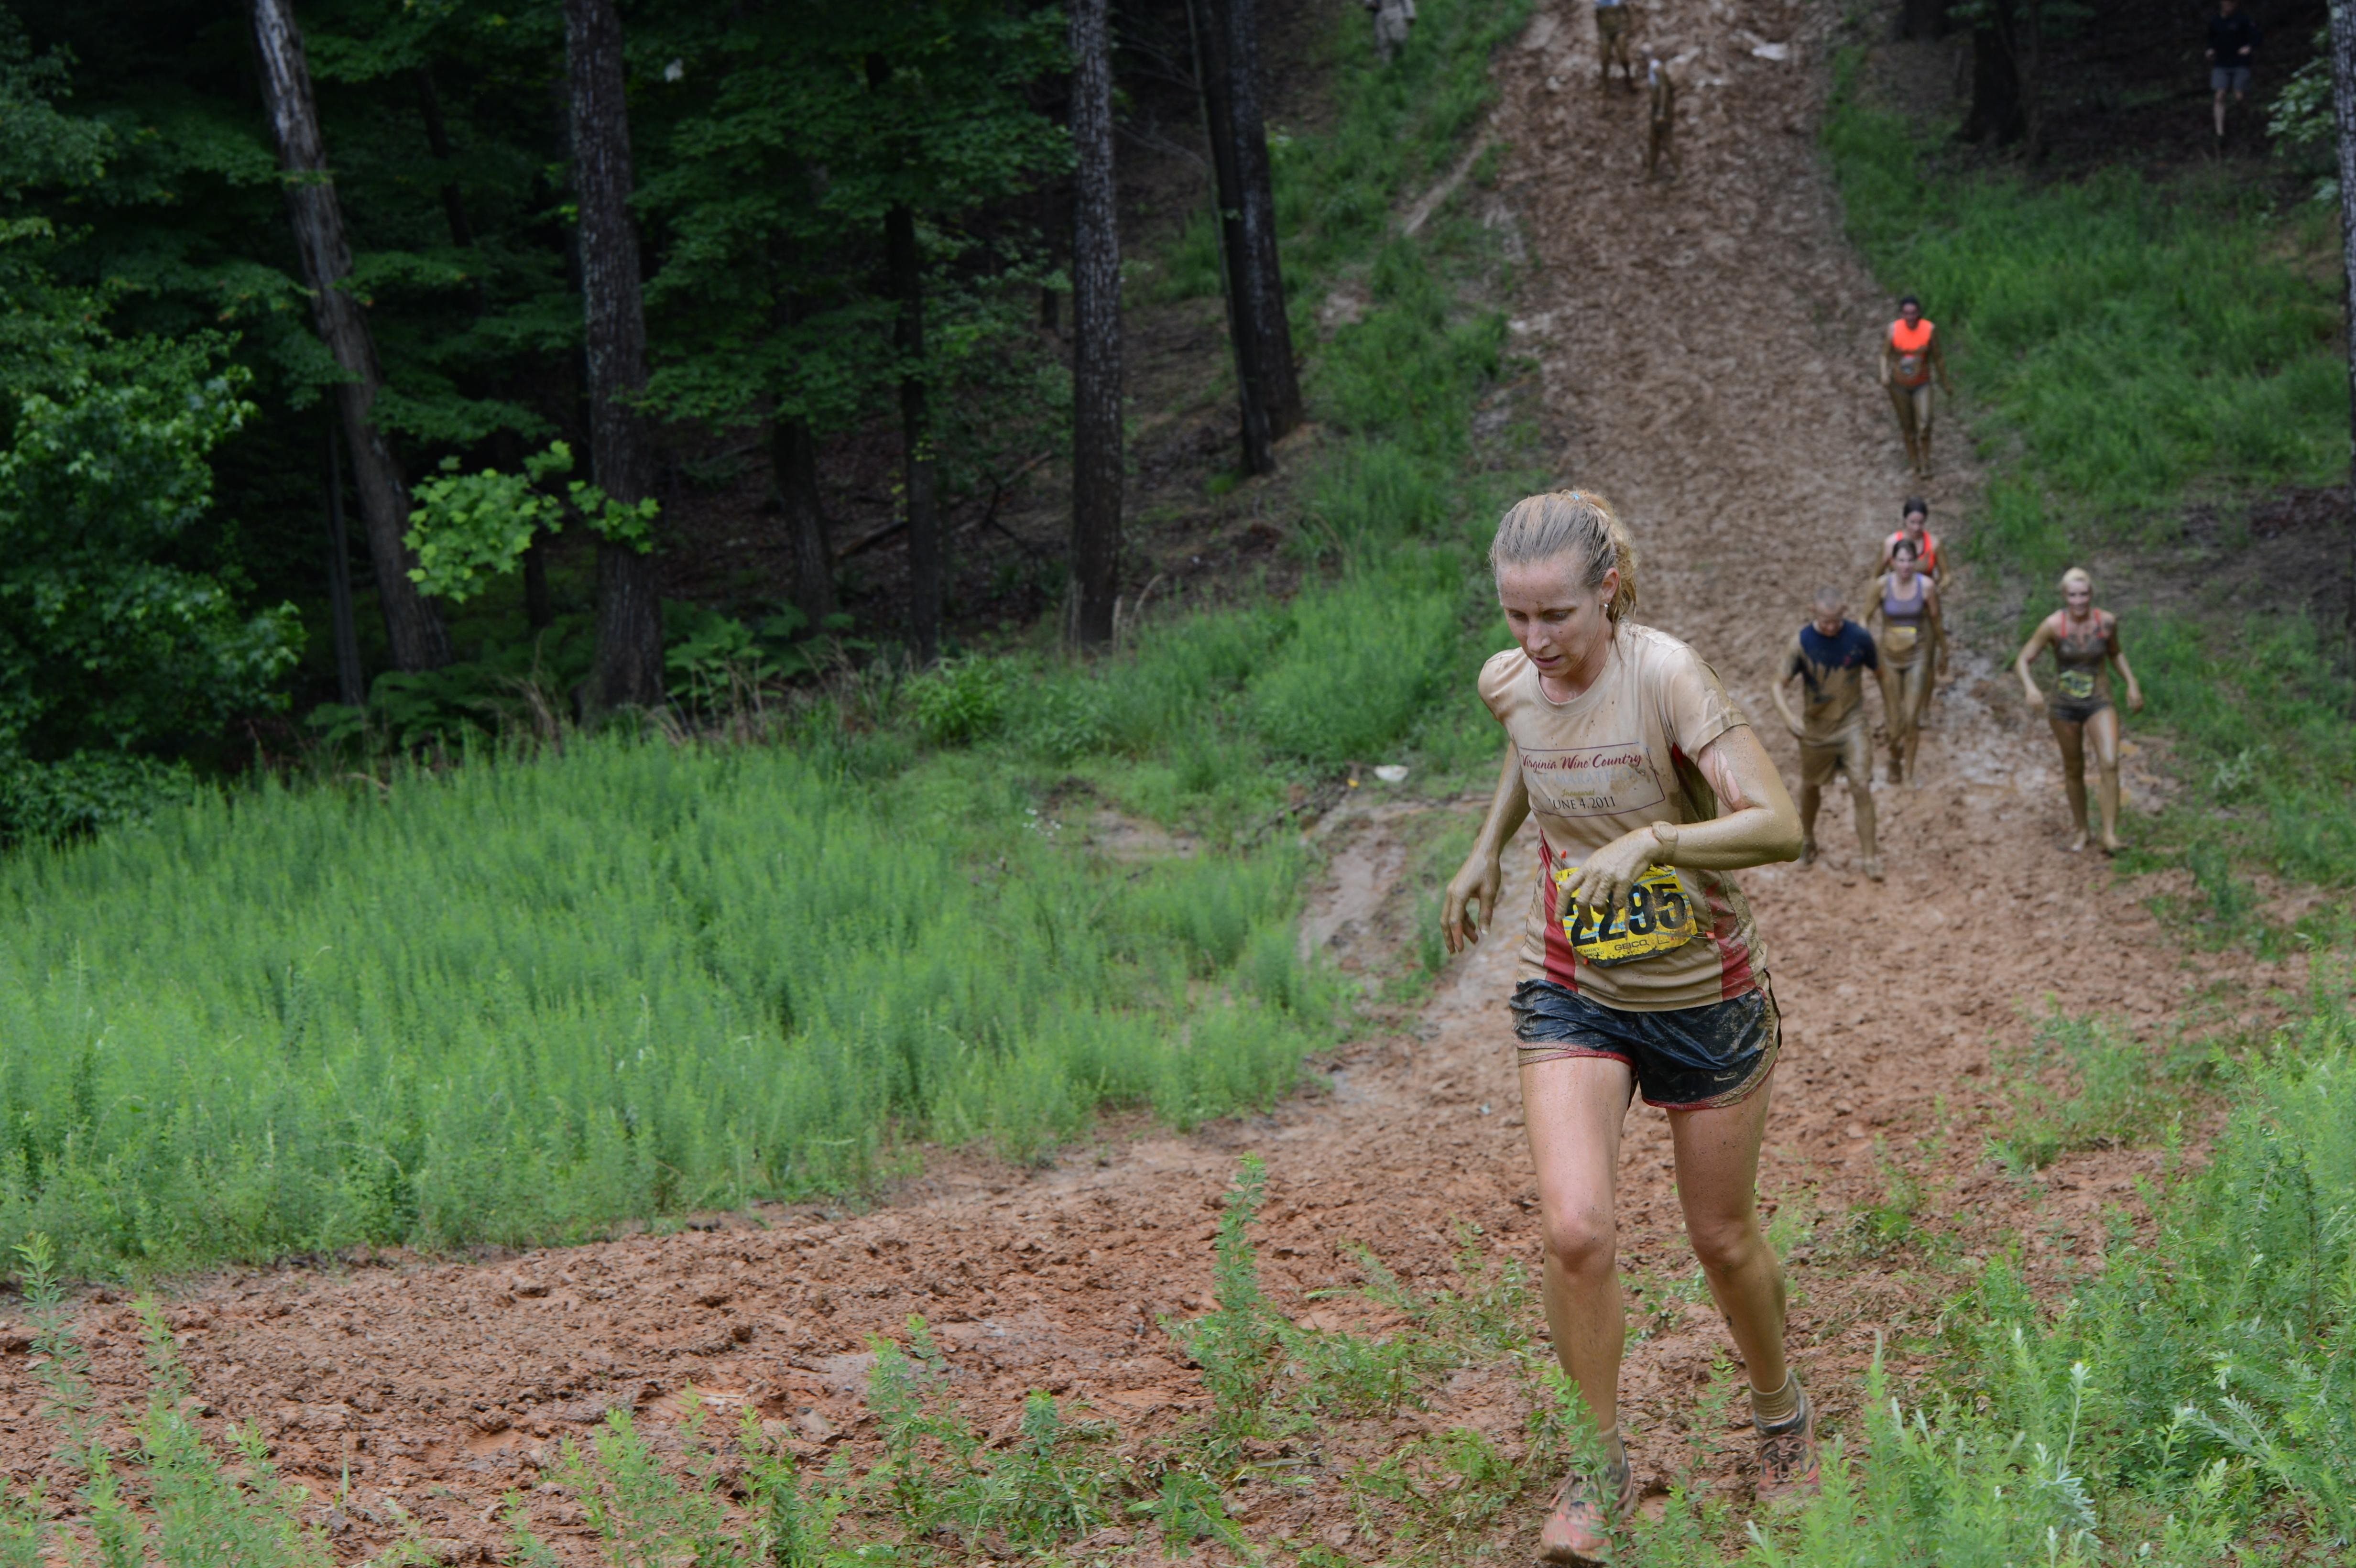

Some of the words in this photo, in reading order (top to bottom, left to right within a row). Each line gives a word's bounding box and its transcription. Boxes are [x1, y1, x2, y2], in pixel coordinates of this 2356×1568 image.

[1521, 754, 1557, 773] Virginia
[1560, 754, 1588, 769] Wine
[1592, 753, 1641, 768] Country
[1614, 939, 1648, 950] GEICO
